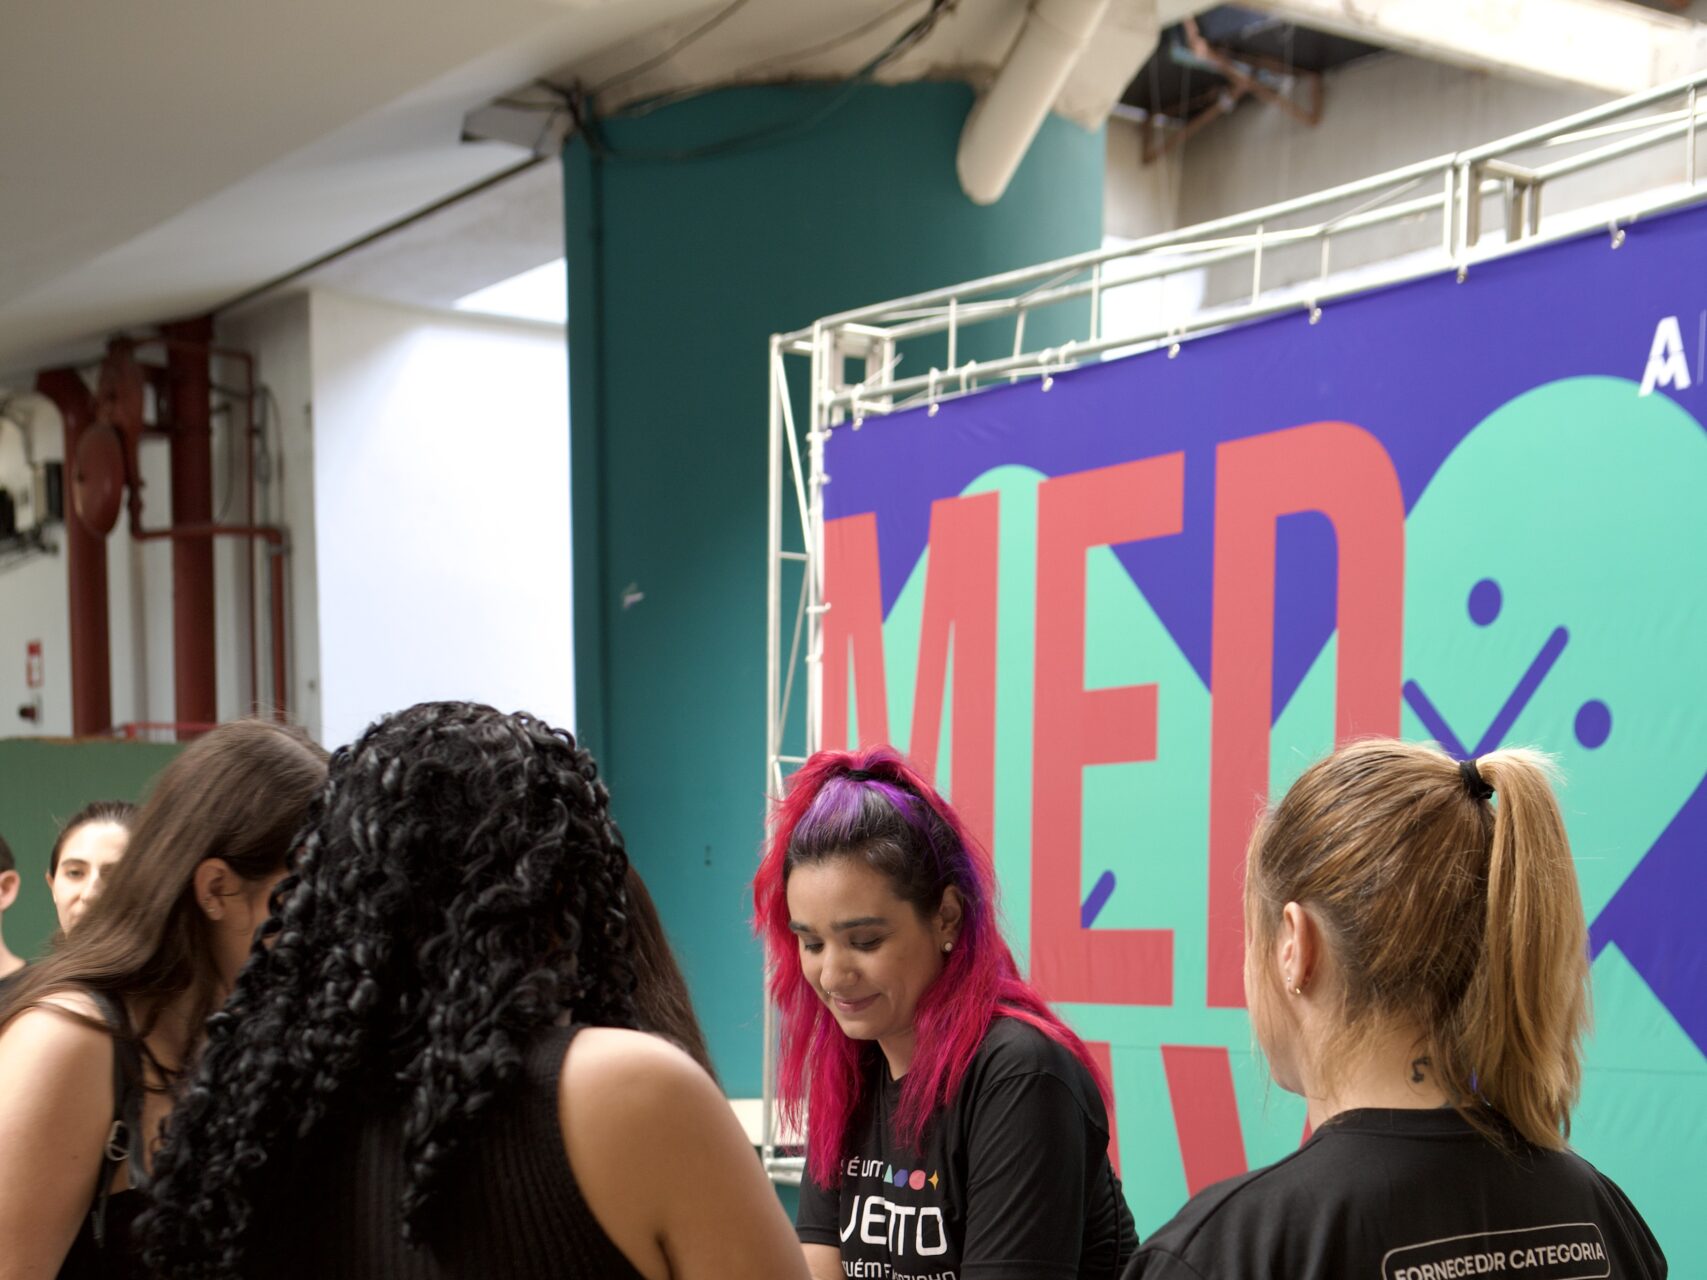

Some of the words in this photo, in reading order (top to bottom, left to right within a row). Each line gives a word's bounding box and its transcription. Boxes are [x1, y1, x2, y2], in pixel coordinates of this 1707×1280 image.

[823, 421, 1406, 1008] MED
[847, 1156, 860, 1177] É
[1509, 1242, 1605, 1269] CATEGORIA
[842, 1258, 882, 1278] UÉM
